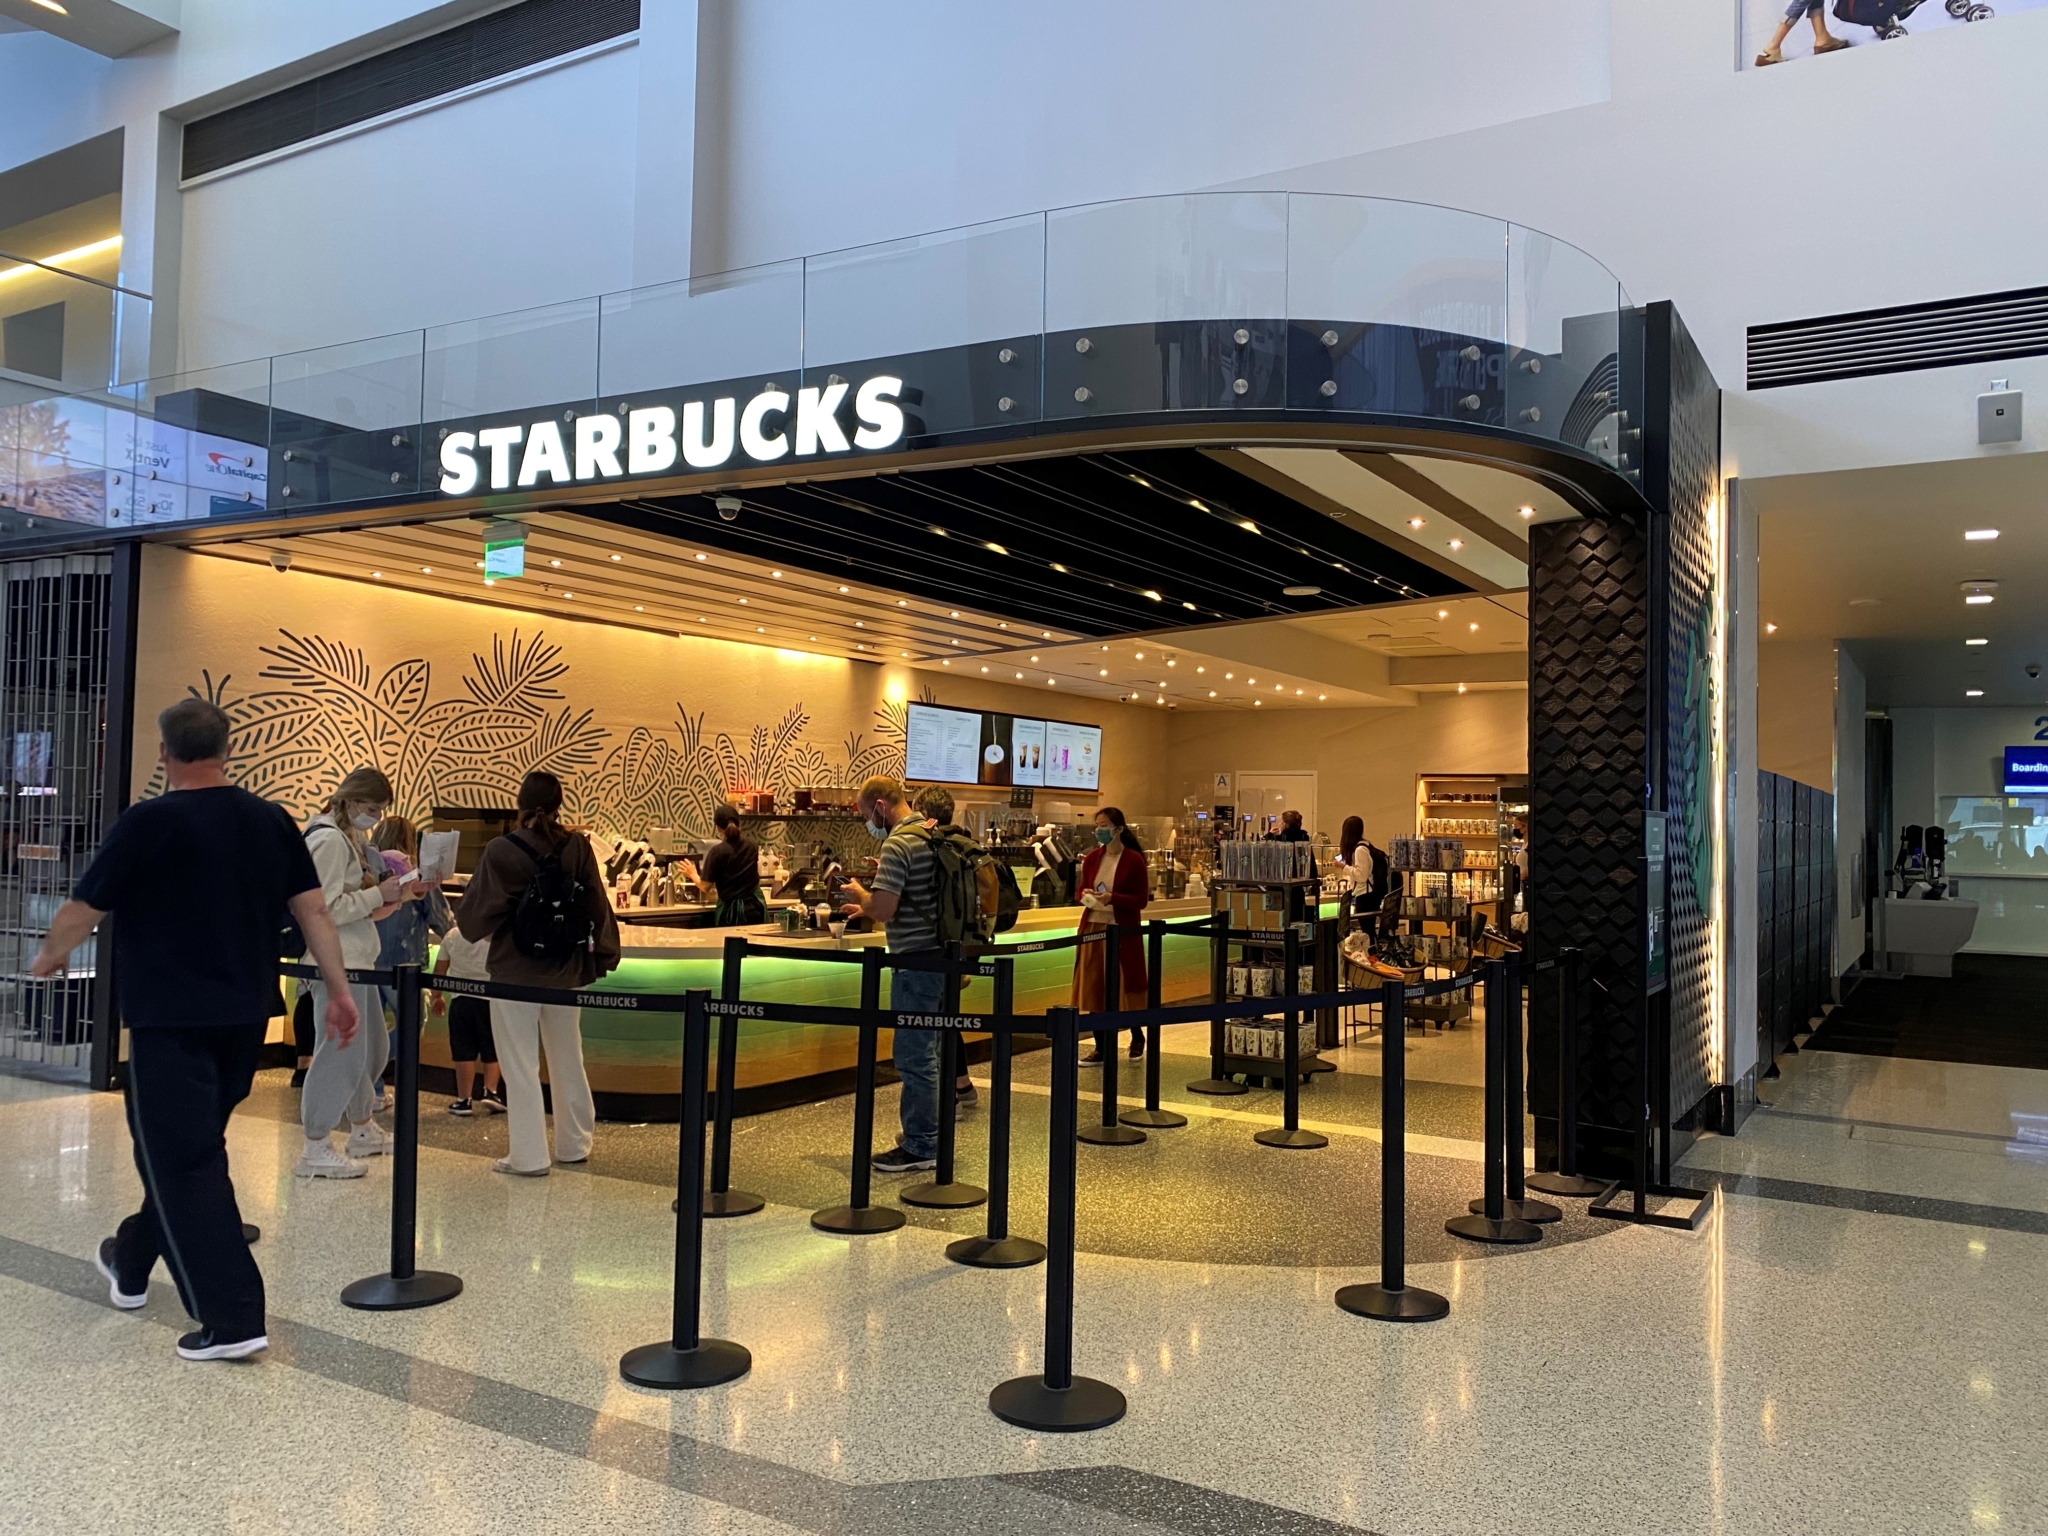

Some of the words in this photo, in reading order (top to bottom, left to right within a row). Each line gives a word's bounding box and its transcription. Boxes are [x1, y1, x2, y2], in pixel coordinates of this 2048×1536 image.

[439, 376, 905, 496] STARBUCKS
[2011, 762, 2048, 774] Boardin
[1217, 774, 1227, 787] A
[1082, 931, 1107, 943] STARBUCKS
[1251, 931, 1285, 940] STARBUC
[1016, 942, 1045, 953] STARBUCKS
[432, 977, 486, 994] STARBUCKS
[576, 993, 638, 1008] STARBUCKS
[703, 1002, 765, 1017] ARBUCKS
[896, 1014, 982, 1029] STARBUCKS
